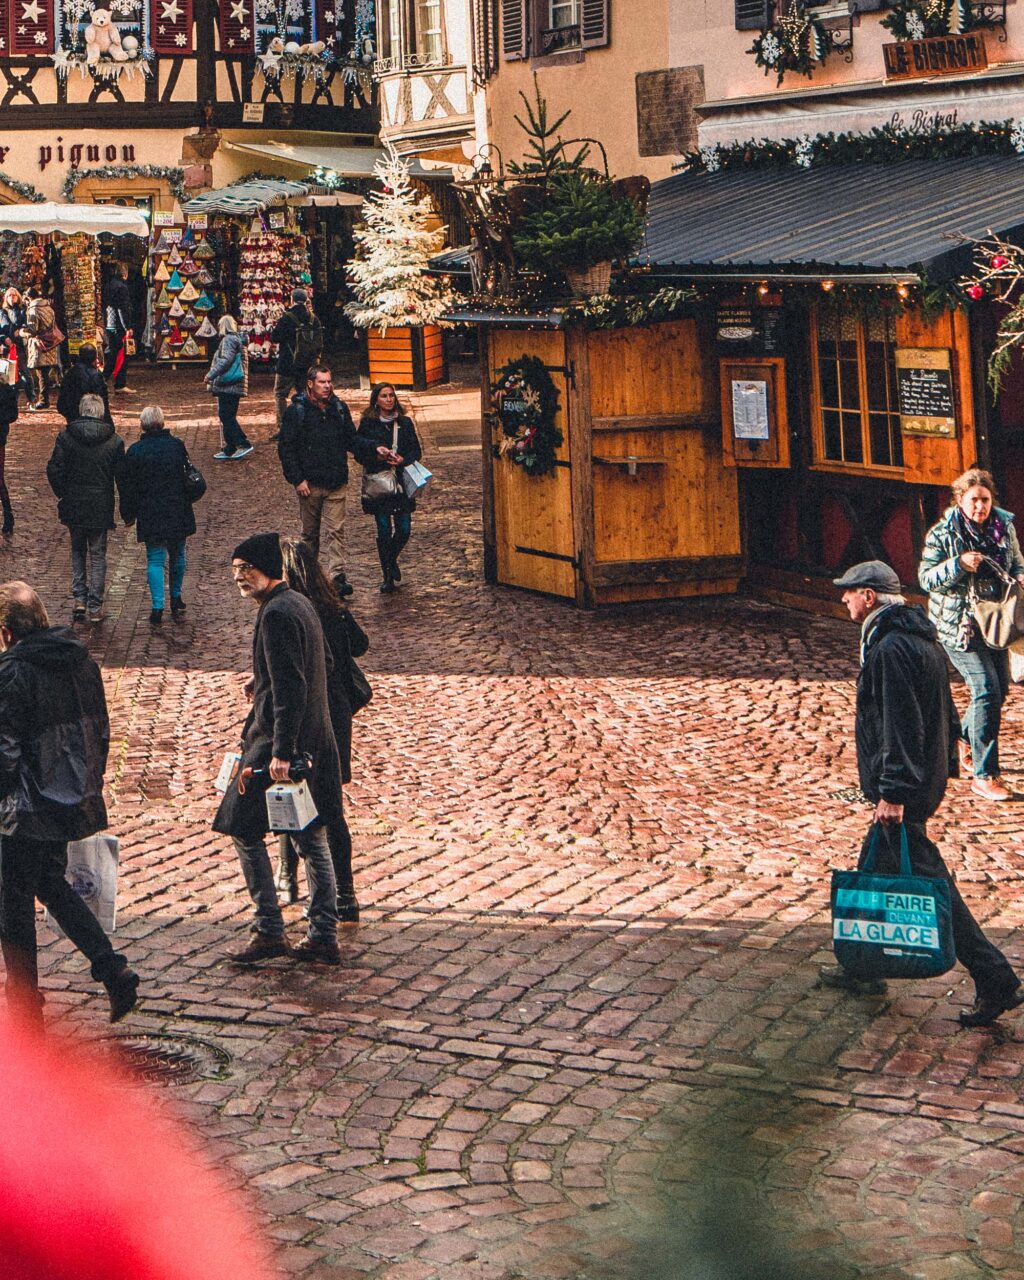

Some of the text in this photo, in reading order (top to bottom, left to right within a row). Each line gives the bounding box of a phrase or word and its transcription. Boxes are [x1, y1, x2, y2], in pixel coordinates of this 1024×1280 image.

[884, 37, 980, 75] LE BISTROT
[890, 111, 906, 131] Le
[38, 136, 136, 172] pignon
[885, 894, 933, 913] FAIRE
[889, 911, 931, 925] DEVANT
[838, 920, 933, 946] LA GLACE
